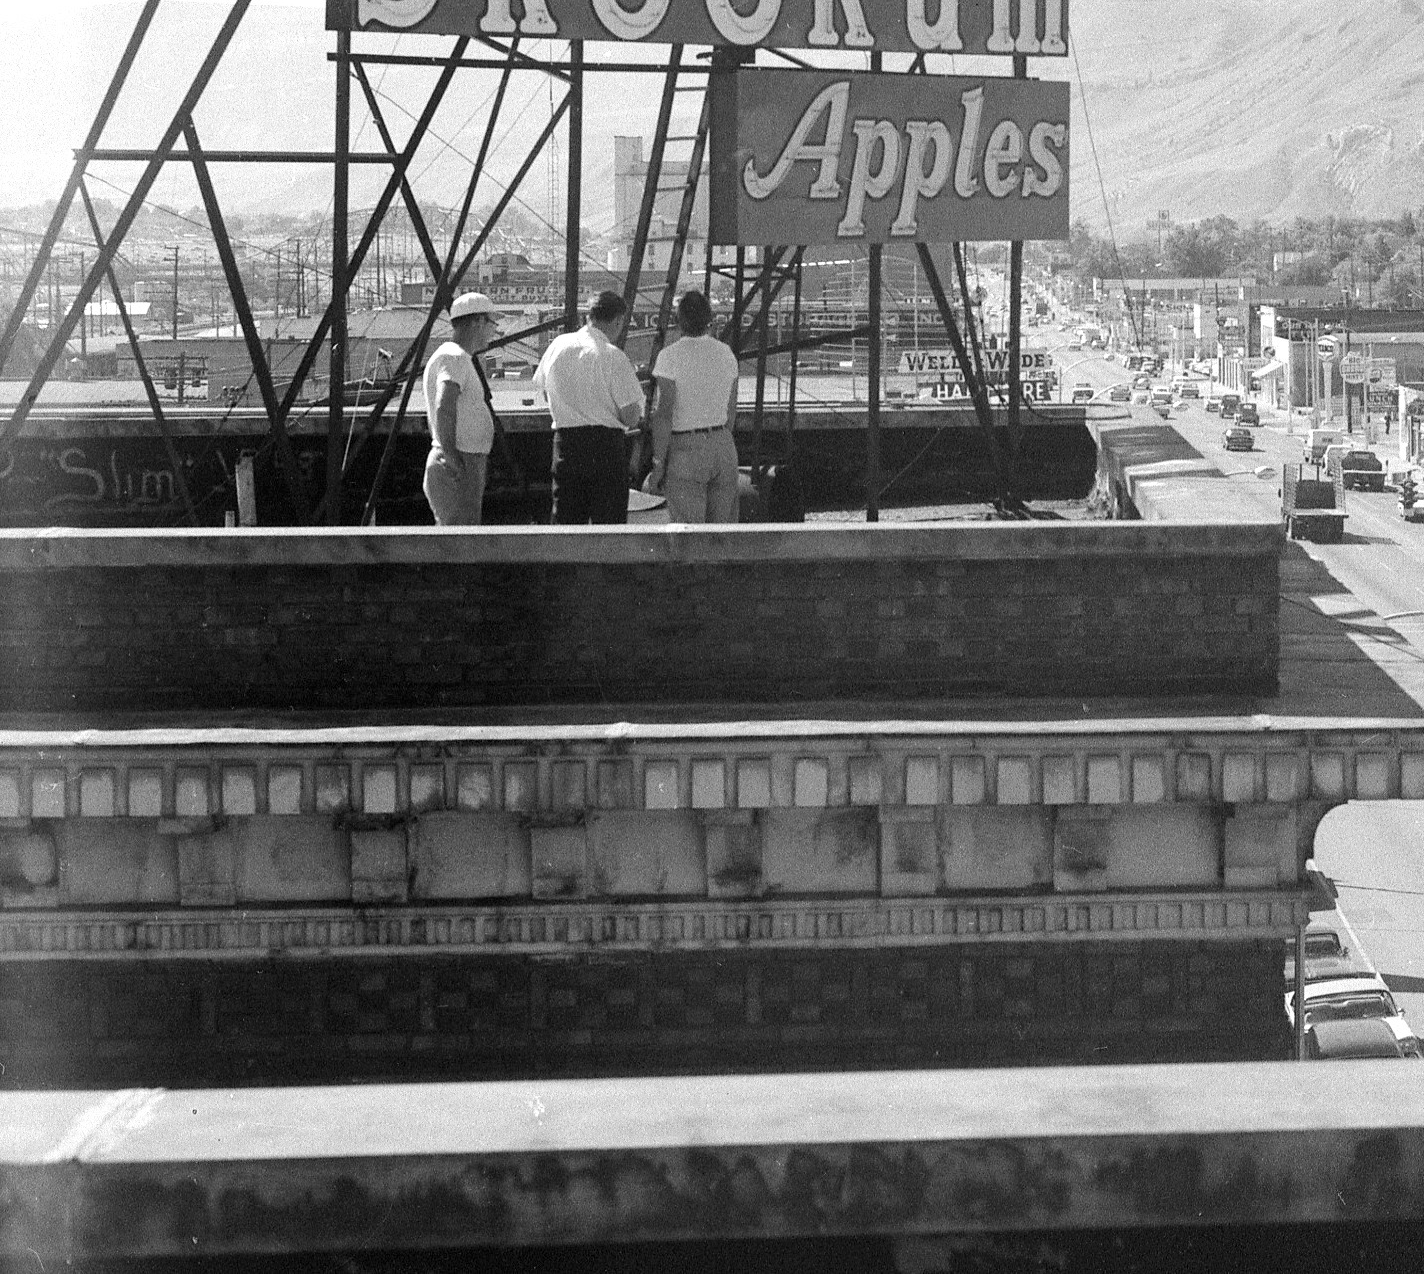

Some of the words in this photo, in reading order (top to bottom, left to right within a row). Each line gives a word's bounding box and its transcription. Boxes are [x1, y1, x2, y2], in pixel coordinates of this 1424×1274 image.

[743, 80, 1067, 237] Apples
[425, 284, 509, 296] NTHERN
[905, 352, 973, 371] WELL
[986, 352, 1046, 370] WDE
